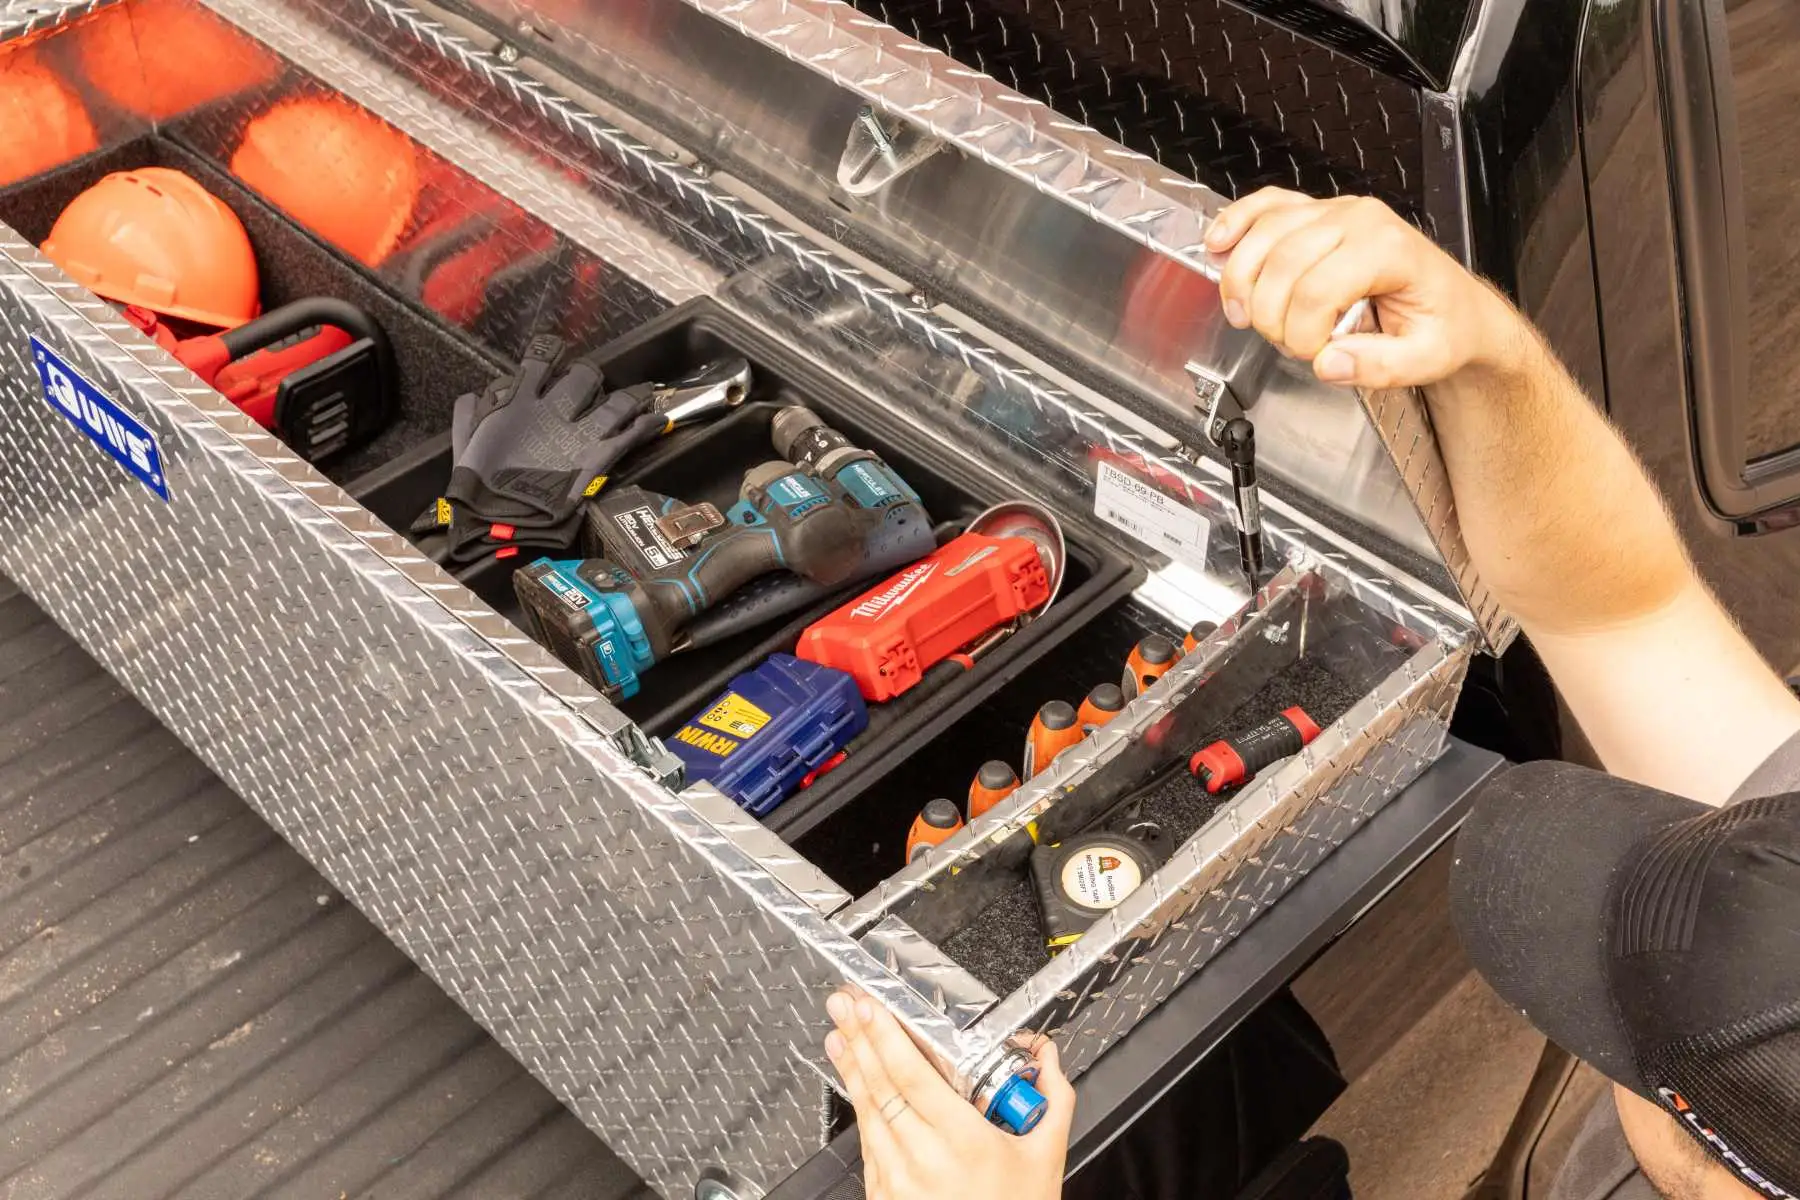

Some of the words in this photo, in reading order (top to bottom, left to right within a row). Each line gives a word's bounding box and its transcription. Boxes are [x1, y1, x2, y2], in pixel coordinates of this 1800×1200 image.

[851, 562, 933, 619] Milwaukee
[674, 725, 739, 758] IRWIN
[1684, 1111, 1800, 1200] LIPPER
